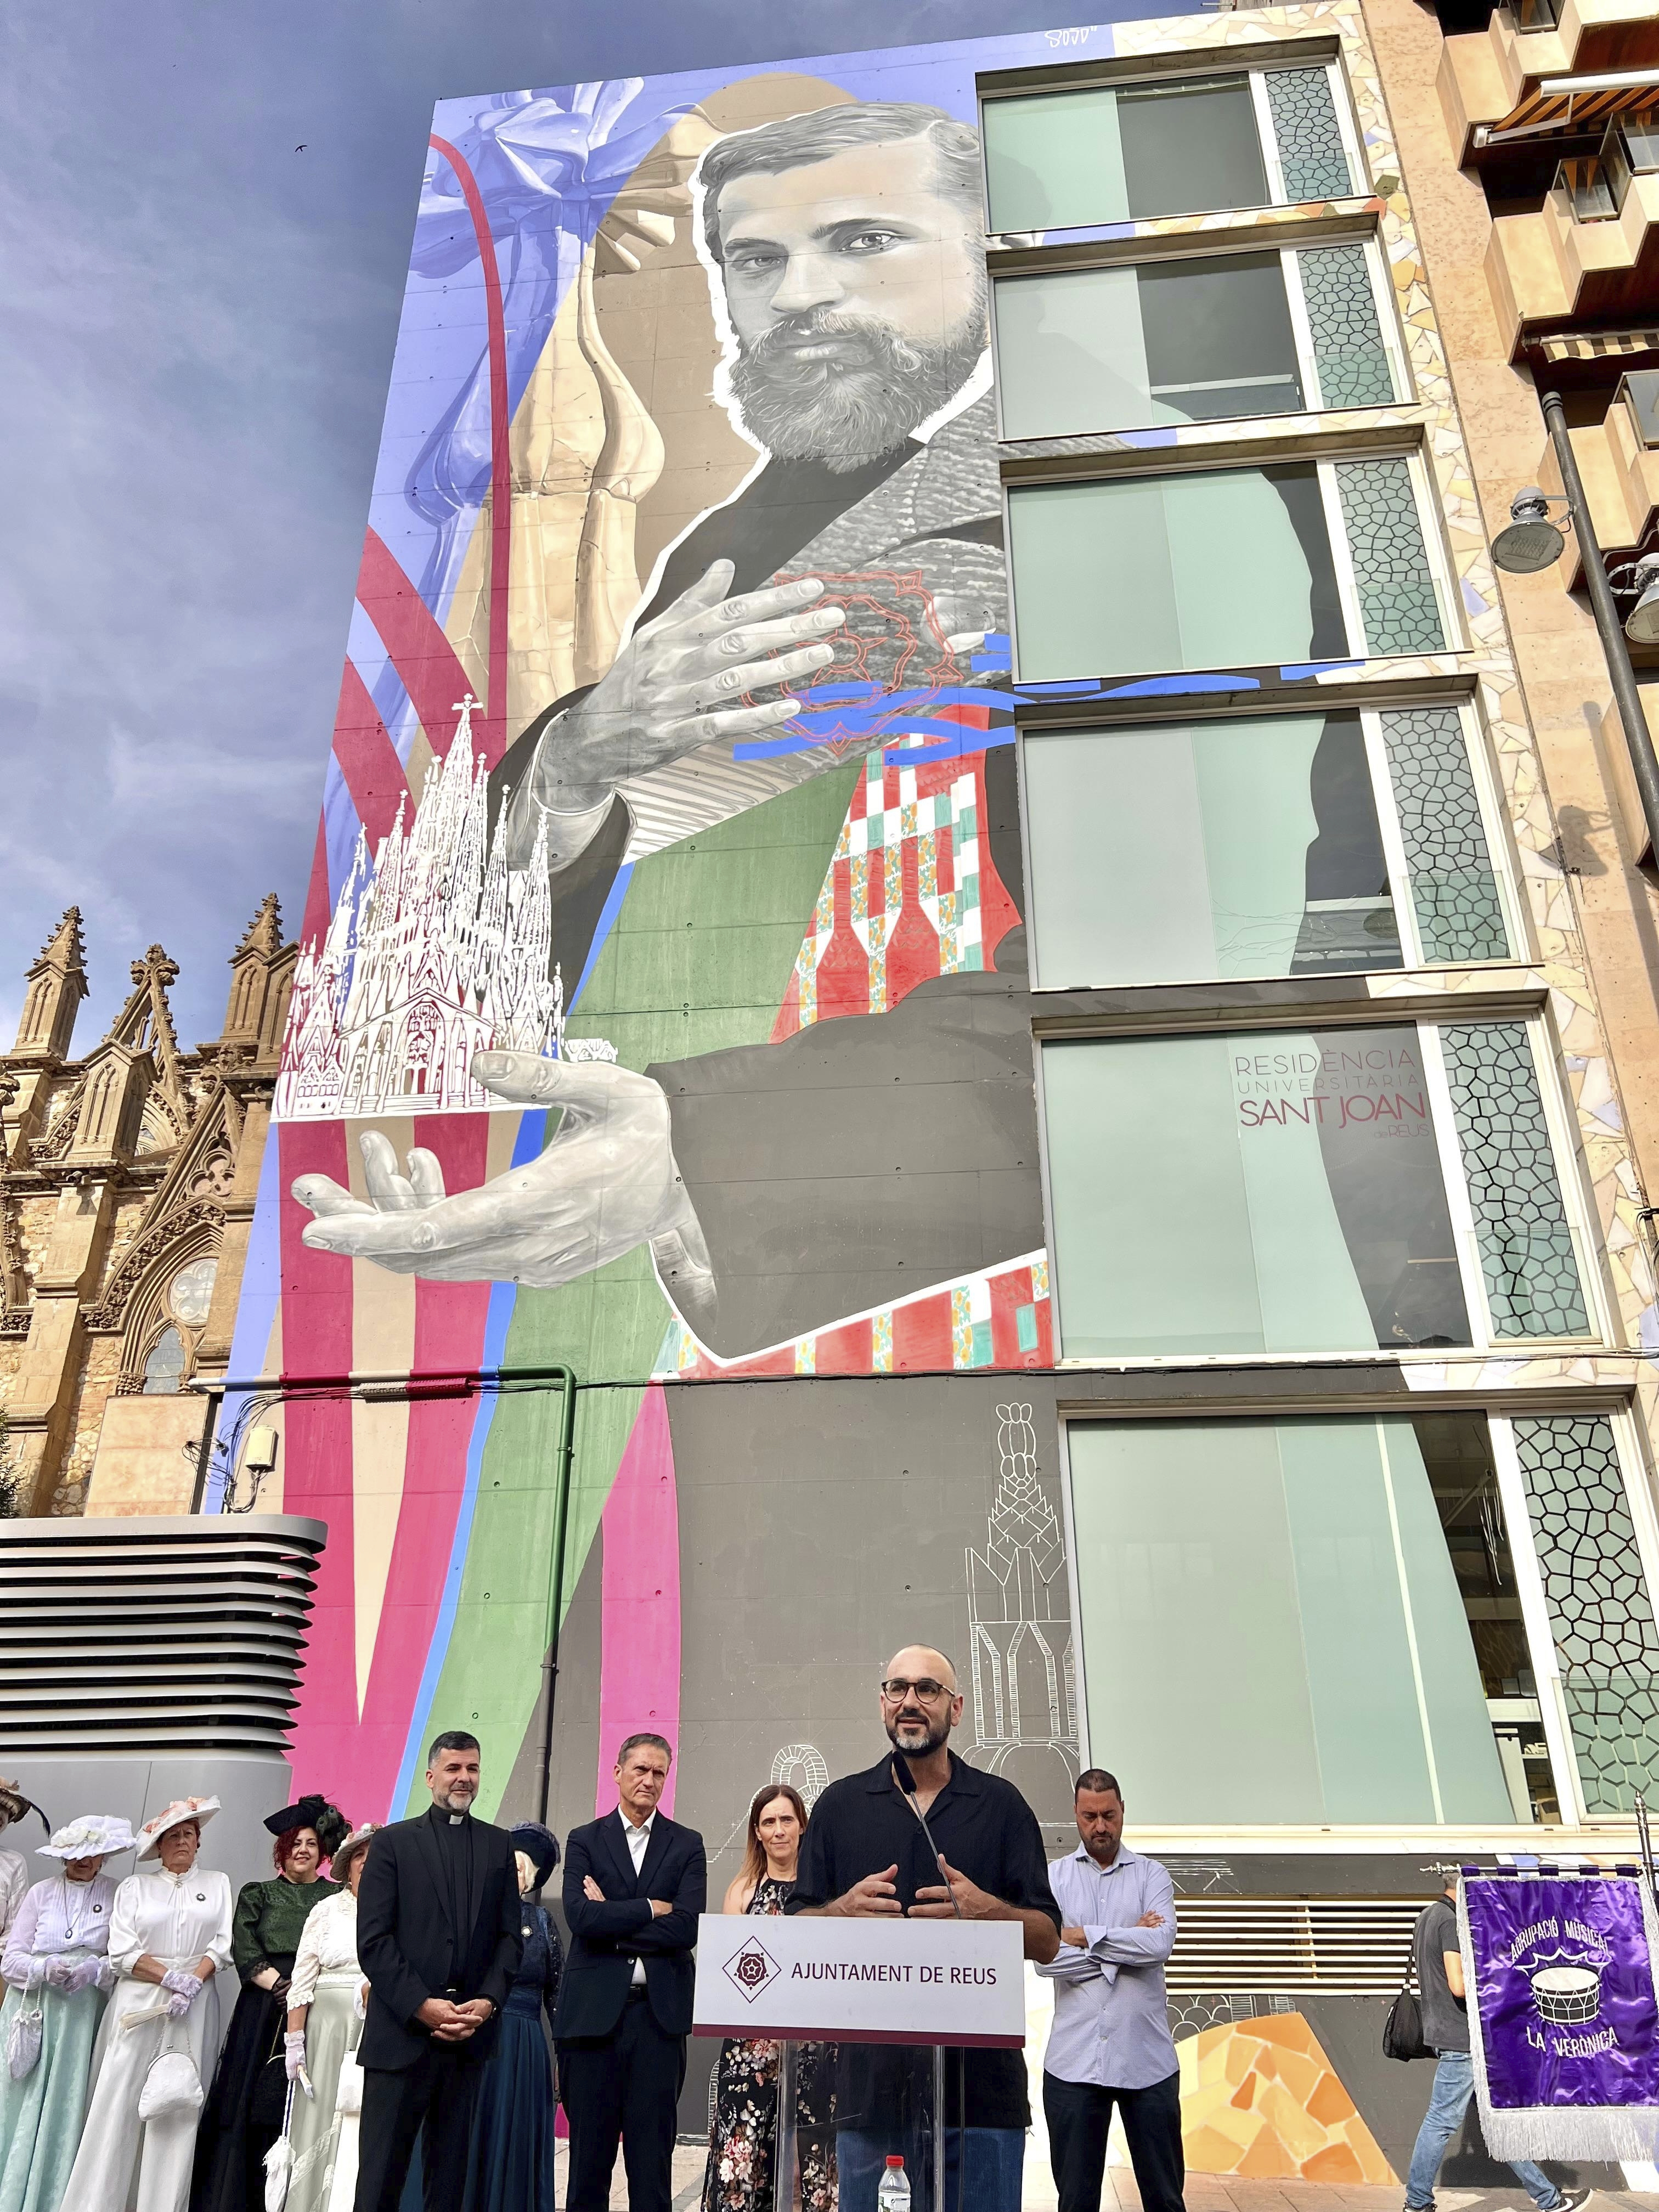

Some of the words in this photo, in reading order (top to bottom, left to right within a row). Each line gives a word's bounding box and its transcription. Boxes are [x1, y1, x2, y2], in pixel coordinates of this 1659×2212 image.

[1235, 1049, 1415, 1076] RESIDÈNCIA
[1238, 1074, 1419, 1094] UNIVERSITÀRIA
[1239, 1096, 1330, 1126] SANT
[1339, 1092, 1425, 1128] JOAN
[1388, 1124, 1429, 1137] REUS
[1510, 1916, 1559, 1963] AGRUPACIÓ
[791, 1962, 913, 1982] AJUNTAMENT
[920, 1966, 944, 1983] DE
[951, 1967, 996, 1985] REUS
[1526, 2026, 1546, 2052] LA
